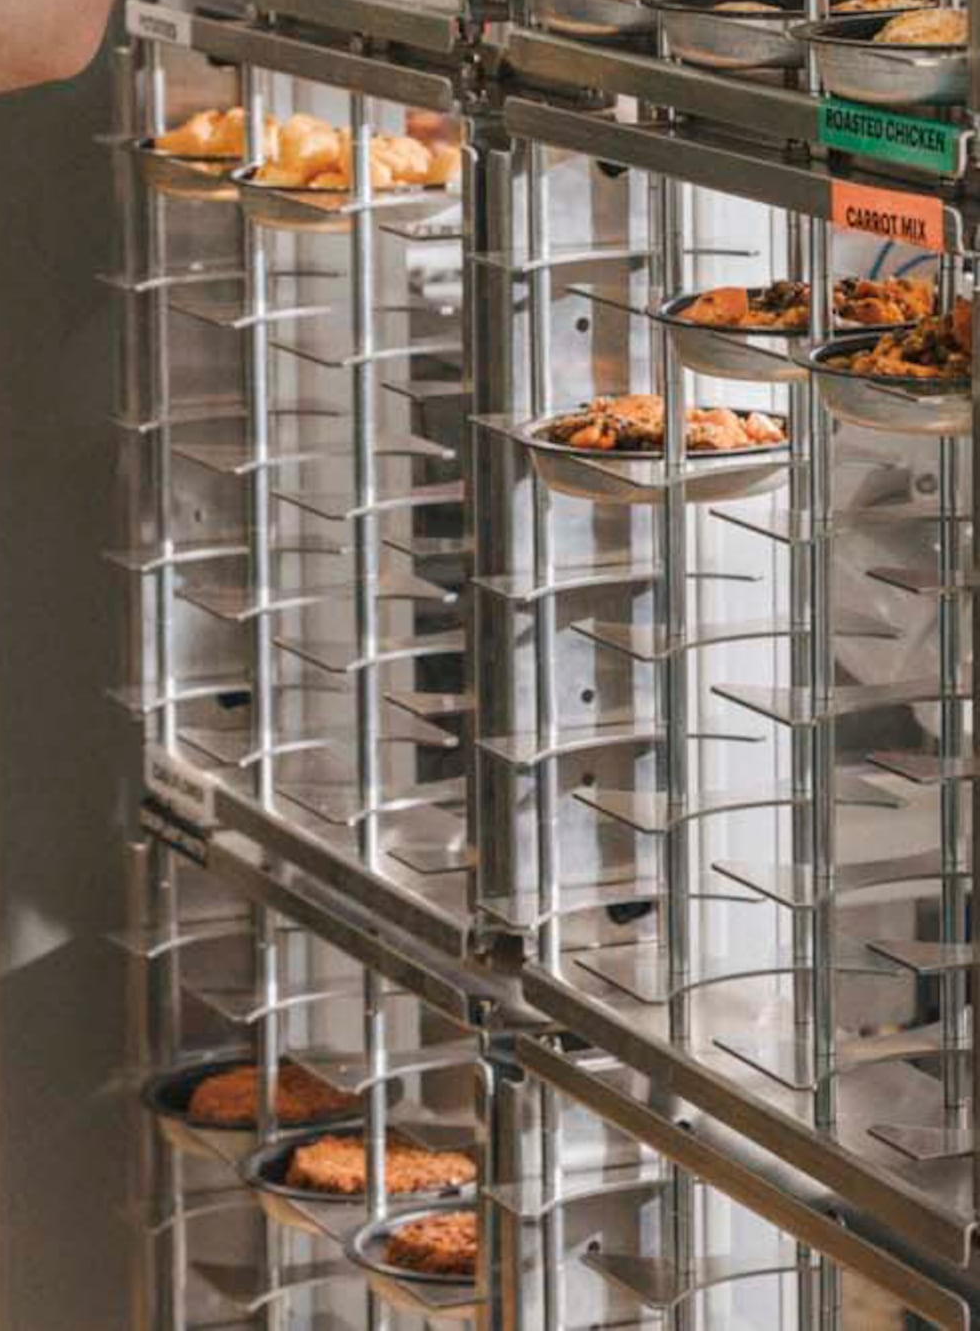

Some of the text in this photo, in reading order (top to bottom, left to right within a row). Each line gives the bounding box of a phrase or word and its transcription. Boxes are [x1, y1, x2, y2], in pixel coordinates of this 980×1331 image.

[826, 108, 945, 153] ROASTED CHICKEN
[846, 206, 926, 242] CARROT MIX
